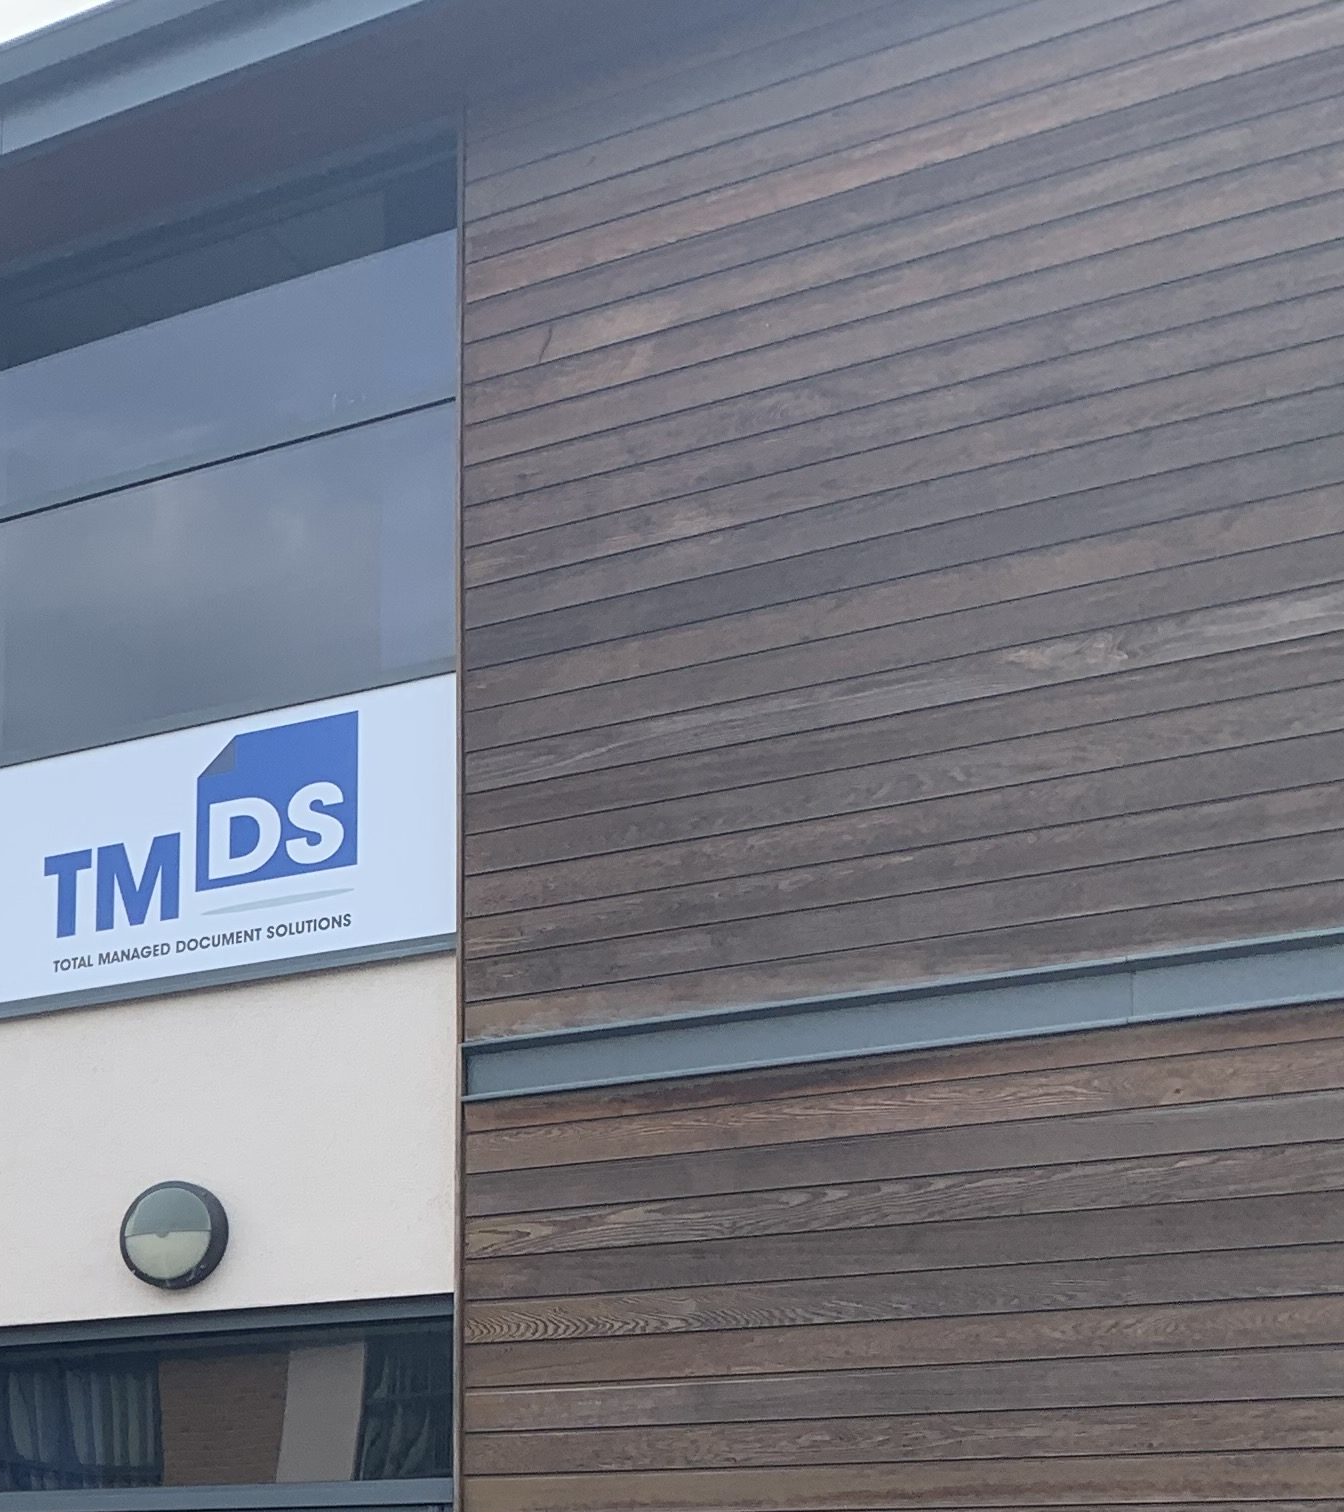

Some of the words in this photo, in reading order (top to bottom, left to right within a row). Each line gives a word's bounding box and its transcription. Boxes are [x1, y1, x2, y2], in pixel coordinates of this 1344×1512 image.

[44, 781, 345, 939] TMDS
[53, 957, 94, 973] TOTAL
[98, 943, 171, 966] MANAGED
[176, 928, 262, 954] DOCUMENT
[266, 913, 352, 940] SOLUTIONS
